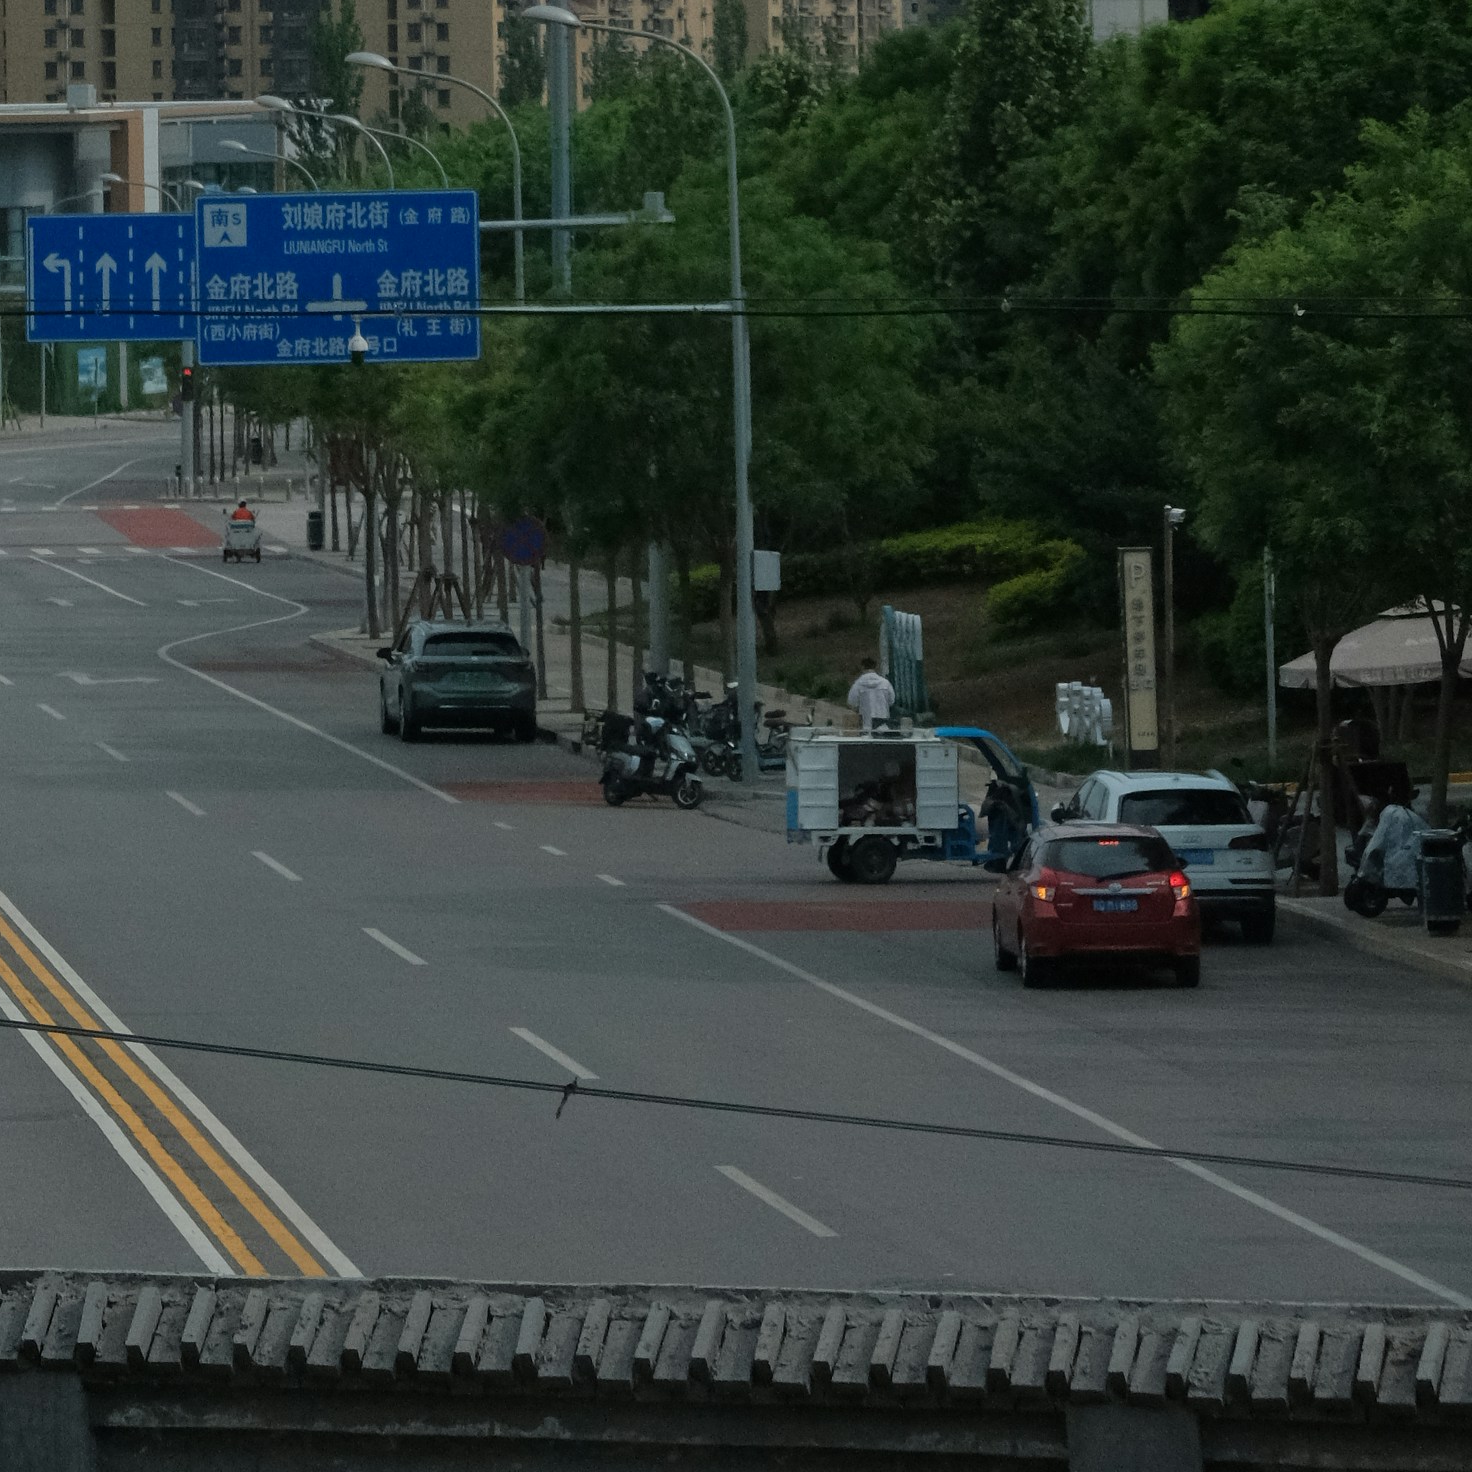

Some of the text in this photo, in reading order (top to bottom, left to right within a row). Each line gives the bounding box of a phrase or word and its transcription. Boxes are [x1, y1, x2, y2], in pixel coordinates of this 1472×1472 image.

[210, 209, 242, 228] 南 S
[281, 201, 389, 231] 刘娘府北街
[284, 238, 388, 255] LIUNIANGFU North St
[205, 271, 299, 300] 金府北路
[377, 268, 470, 298] 金府北路
[276, 336, 397, 358] 金府北路号口
